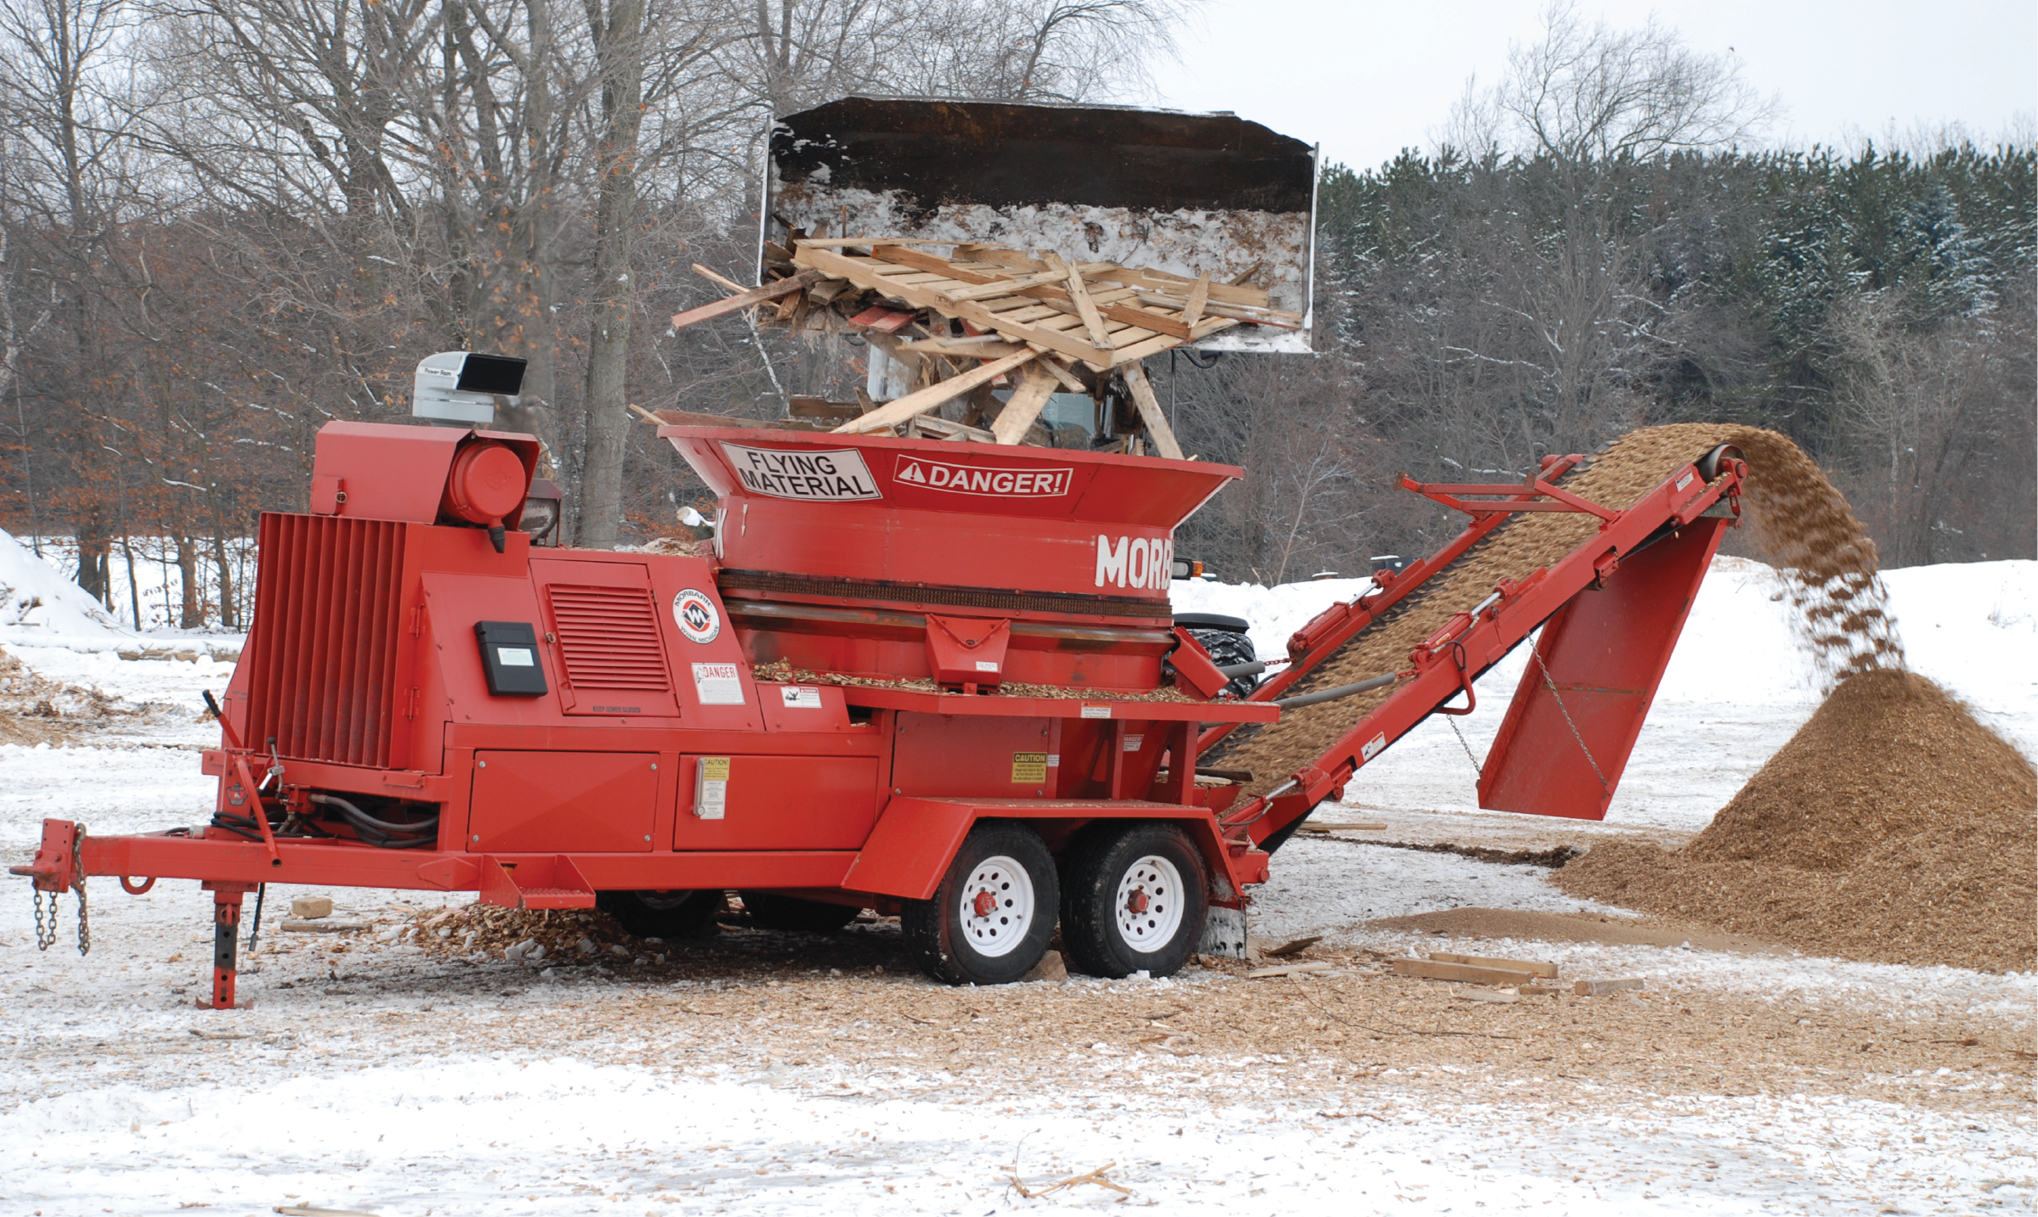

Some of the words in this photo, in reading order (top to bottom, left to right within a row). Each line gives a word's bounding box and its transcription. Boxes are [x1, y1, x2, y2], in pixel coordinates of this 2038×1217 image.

[746, 451, 837, 475] FLYING
[738, 467, 874, 496] MATERIAL
[929, 465, 1063, 493] DANGER!
[674, 590, 713, 608] MORBARK
[703, 666, 736, 678] DANGER
[1015, 754, 1046, 763] CAUTION
